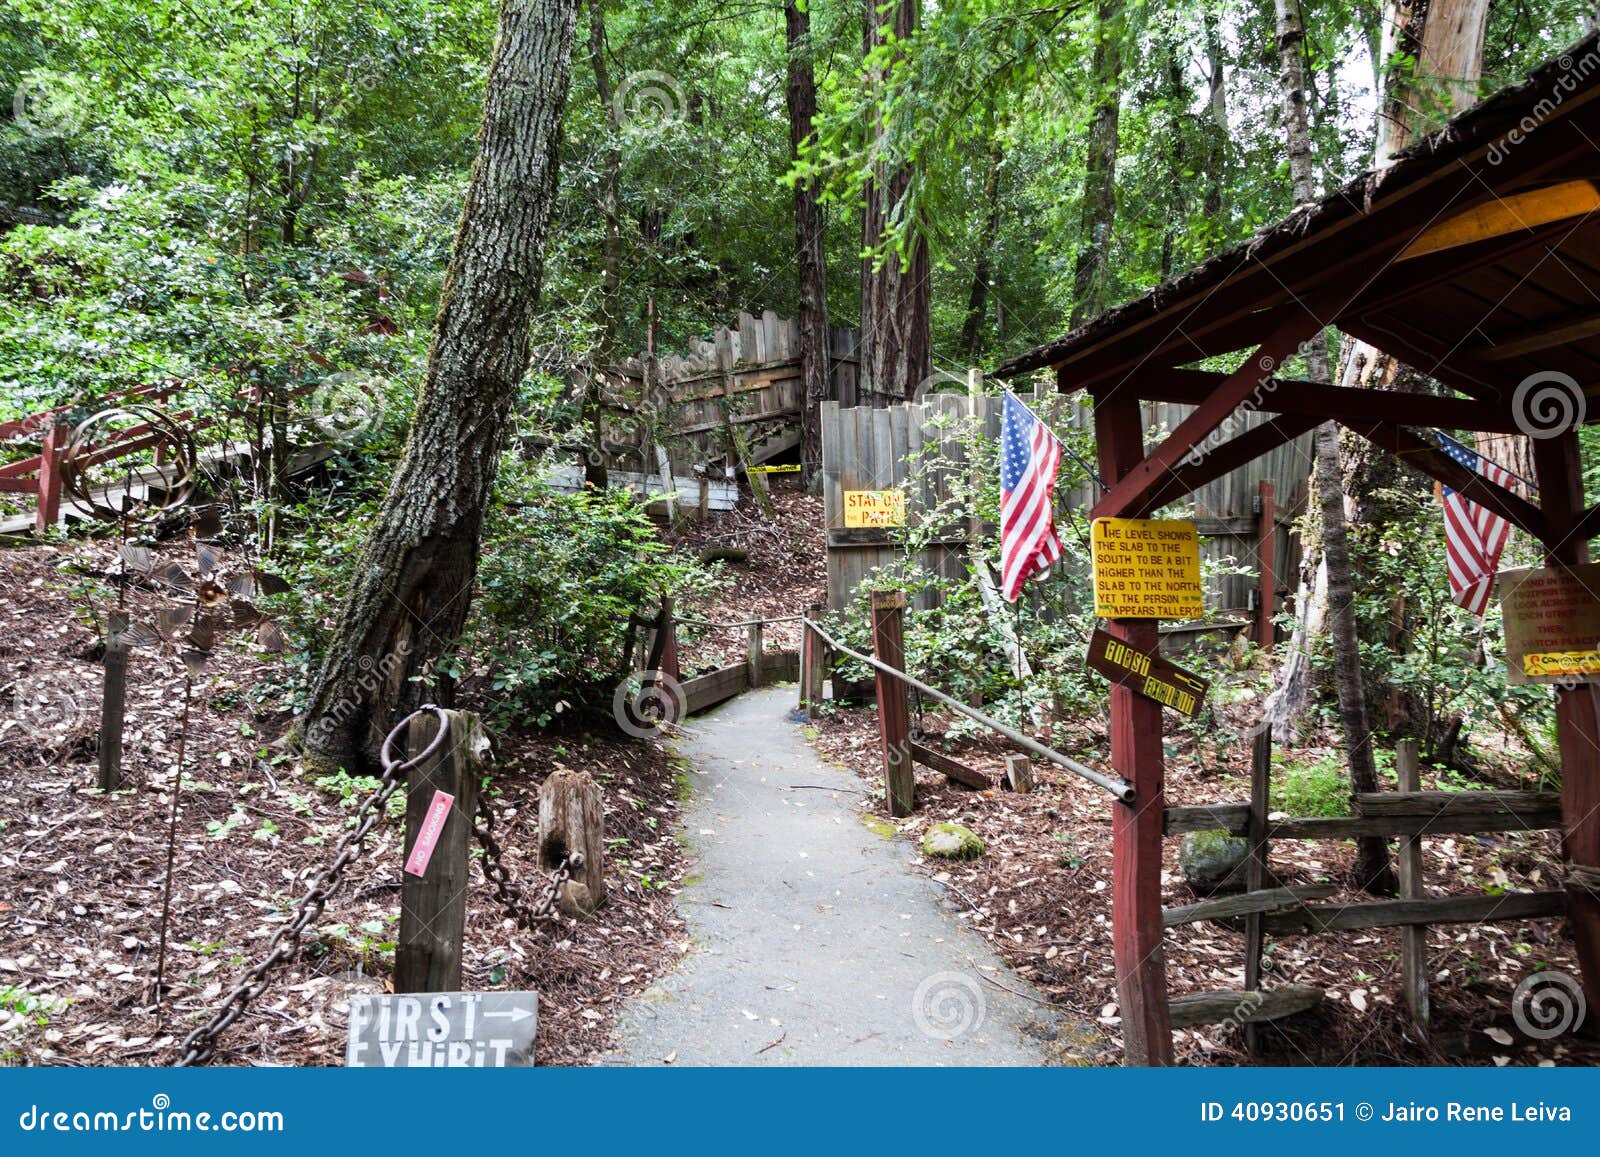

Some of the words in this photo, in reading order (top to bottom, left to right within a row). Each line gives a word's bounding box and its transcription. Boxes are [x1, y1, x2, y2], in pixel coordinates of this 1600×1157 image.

[1098, 521, 1121, 538] THE
[1125, 530, 1155, 540] LEVEL
[1158, 531, 1192, 541] SHOWS
[1097, 541, 1115, 551] THE
[1119, 542, 1143, 552] SLAB
[1146, 543, 1158, 553] TO
[1161, 543, 1181, 553] THE
[1097, 554, 1131, 564] SOUTH
[1136, 555, 1147, 565] TO
[1150, 555, 1163, 565] BE
[1166, 556, 1172, 565] A
[1138, 568, 1163, 578] THAN
[1168, 569, 1184, 579] THE
[1098, 581, 1125, 591] SLAB
[1129, 581, 1141, 591] TO
[1144, 582, 1162, 591] THE
[1097, 593, 1116, 603] YET
[1121, 593, 1139, 603] THE
[1143, 594, 1180, 604] PERSON
[1114, 605, 1155, 616] APPEARS
[1105, 640, 1151, 677] FIRST
[1144, 676, 1196, 715] EXHIBIT
[415, 850, 426, 866] NO
[422, 803, 446, 847] SMOKING
